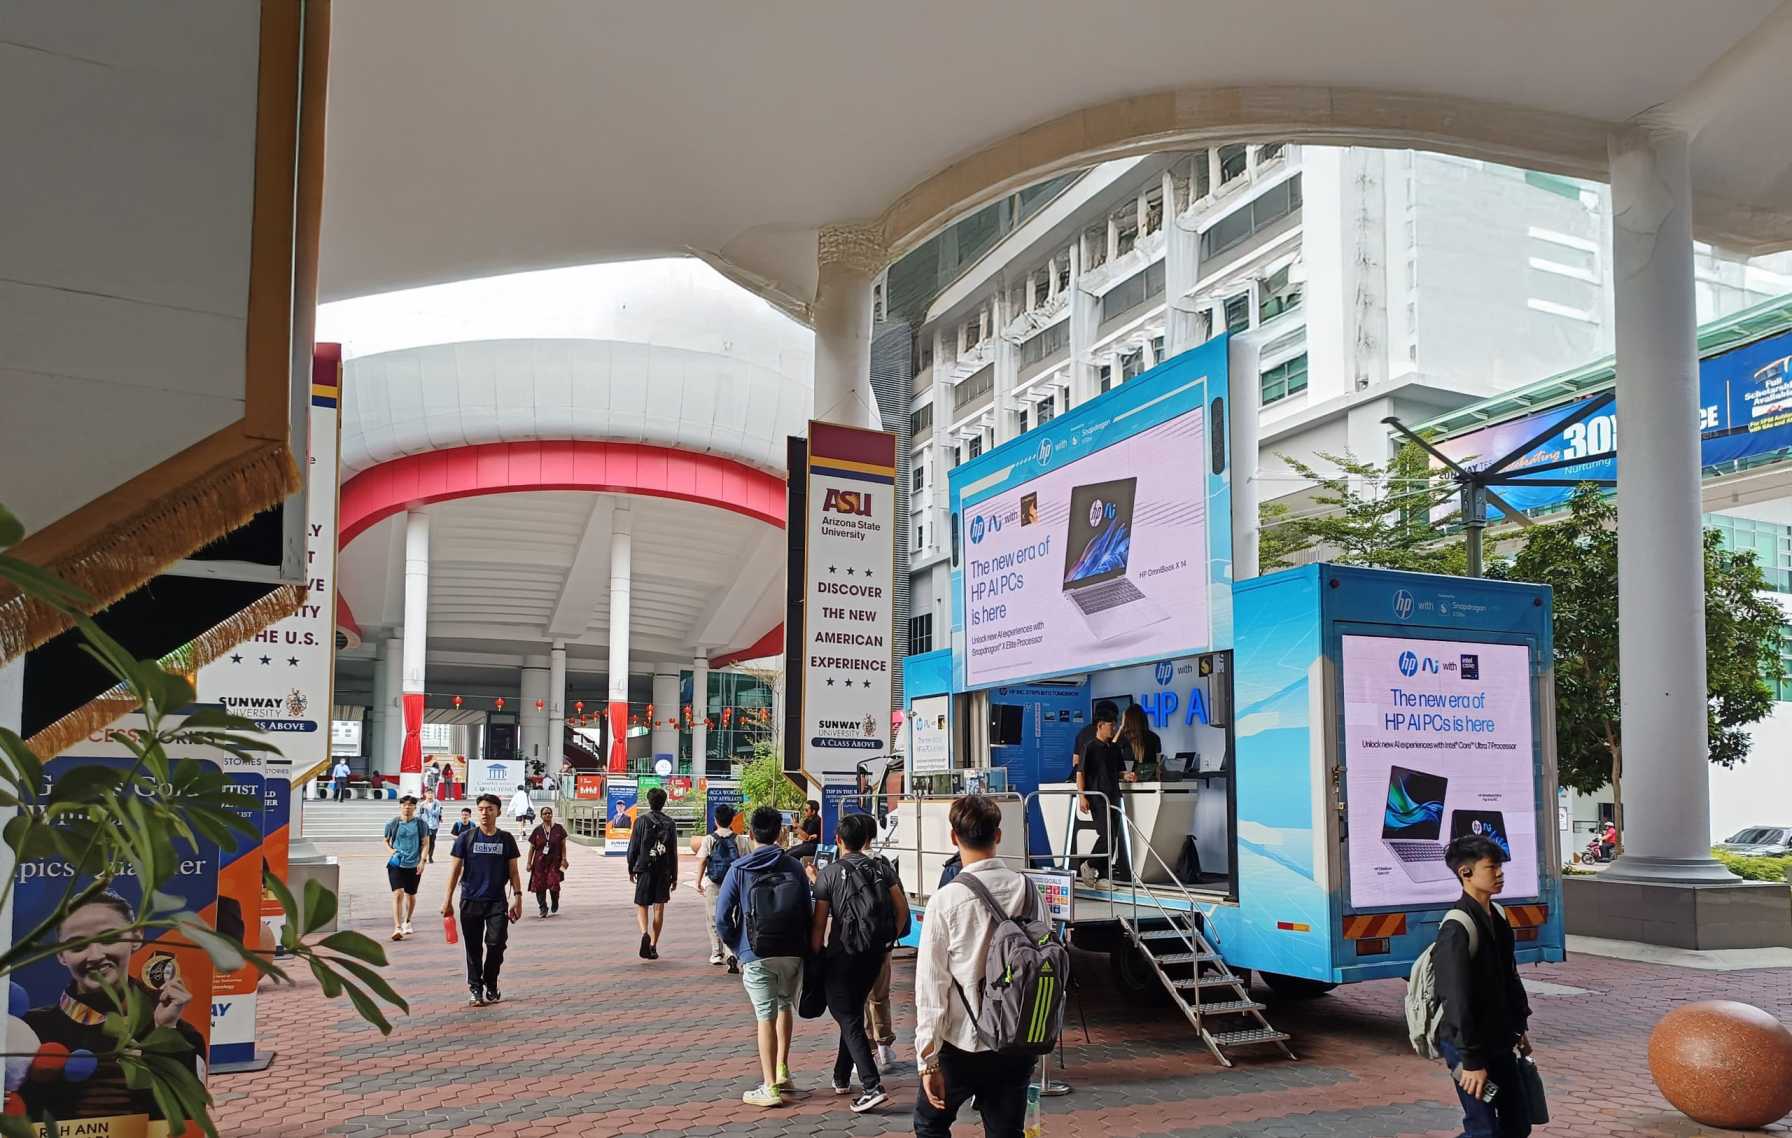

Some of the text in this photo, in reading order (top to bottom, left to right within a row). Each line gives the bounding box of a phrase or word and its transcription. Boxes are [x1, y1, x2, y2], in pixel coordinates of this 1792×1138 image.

[822, 488, 872, 517] ASU
[1089, 499, 1103, 527] hp
[822, 516, 880, 531] Arizona State
[970, 515, 985, 544] hp
[1004, 511, 1018, 523] with
[821, 526, 866, 541] University
[970, 535, 1051, 579] The new era of
[818, 582, 882, 598] DISCOVER
[971, 572, 1024, 603] HP AI PCs
[1418, 600, 1434, 611] with
[823, 607, 877, 622] THE NEW
[971, 603, 1007, 626] is here
[248, 629, 320, 646] HE U.S.
[815, 632, 883, 647] AMERICAN
[810, 656, 887, 671] EXPERIENCE
[1399, 651, 1418, 677] hp
[1443, 661, 1458, 672] with
[1156, 660, 1193, 686] hp with
[219, 696, 283, 708] SUNWAY
[1391, 688, 1486, 709] The new era of
[226, 707, 281, 718] NIVERSITY
[1141, 691, 1178, 728] HP
[268, 721, 305, 731] ABOVE
[818, 720, 861, 730] SUNWAY
[1385, 712, 1495, 732] HP AI PCs is here
[818, 729, 860, 738] UNIVERSITY
[827, 739, 850, 747] CLASS
[851, 740, 876, 748] ABOVE
[1361, 740, 1380, 748] Unlock
[221, 784, 258, 796] TIST
[19, 857, 76, 884] pics
[75, 1121, 109, 1135] ANN
